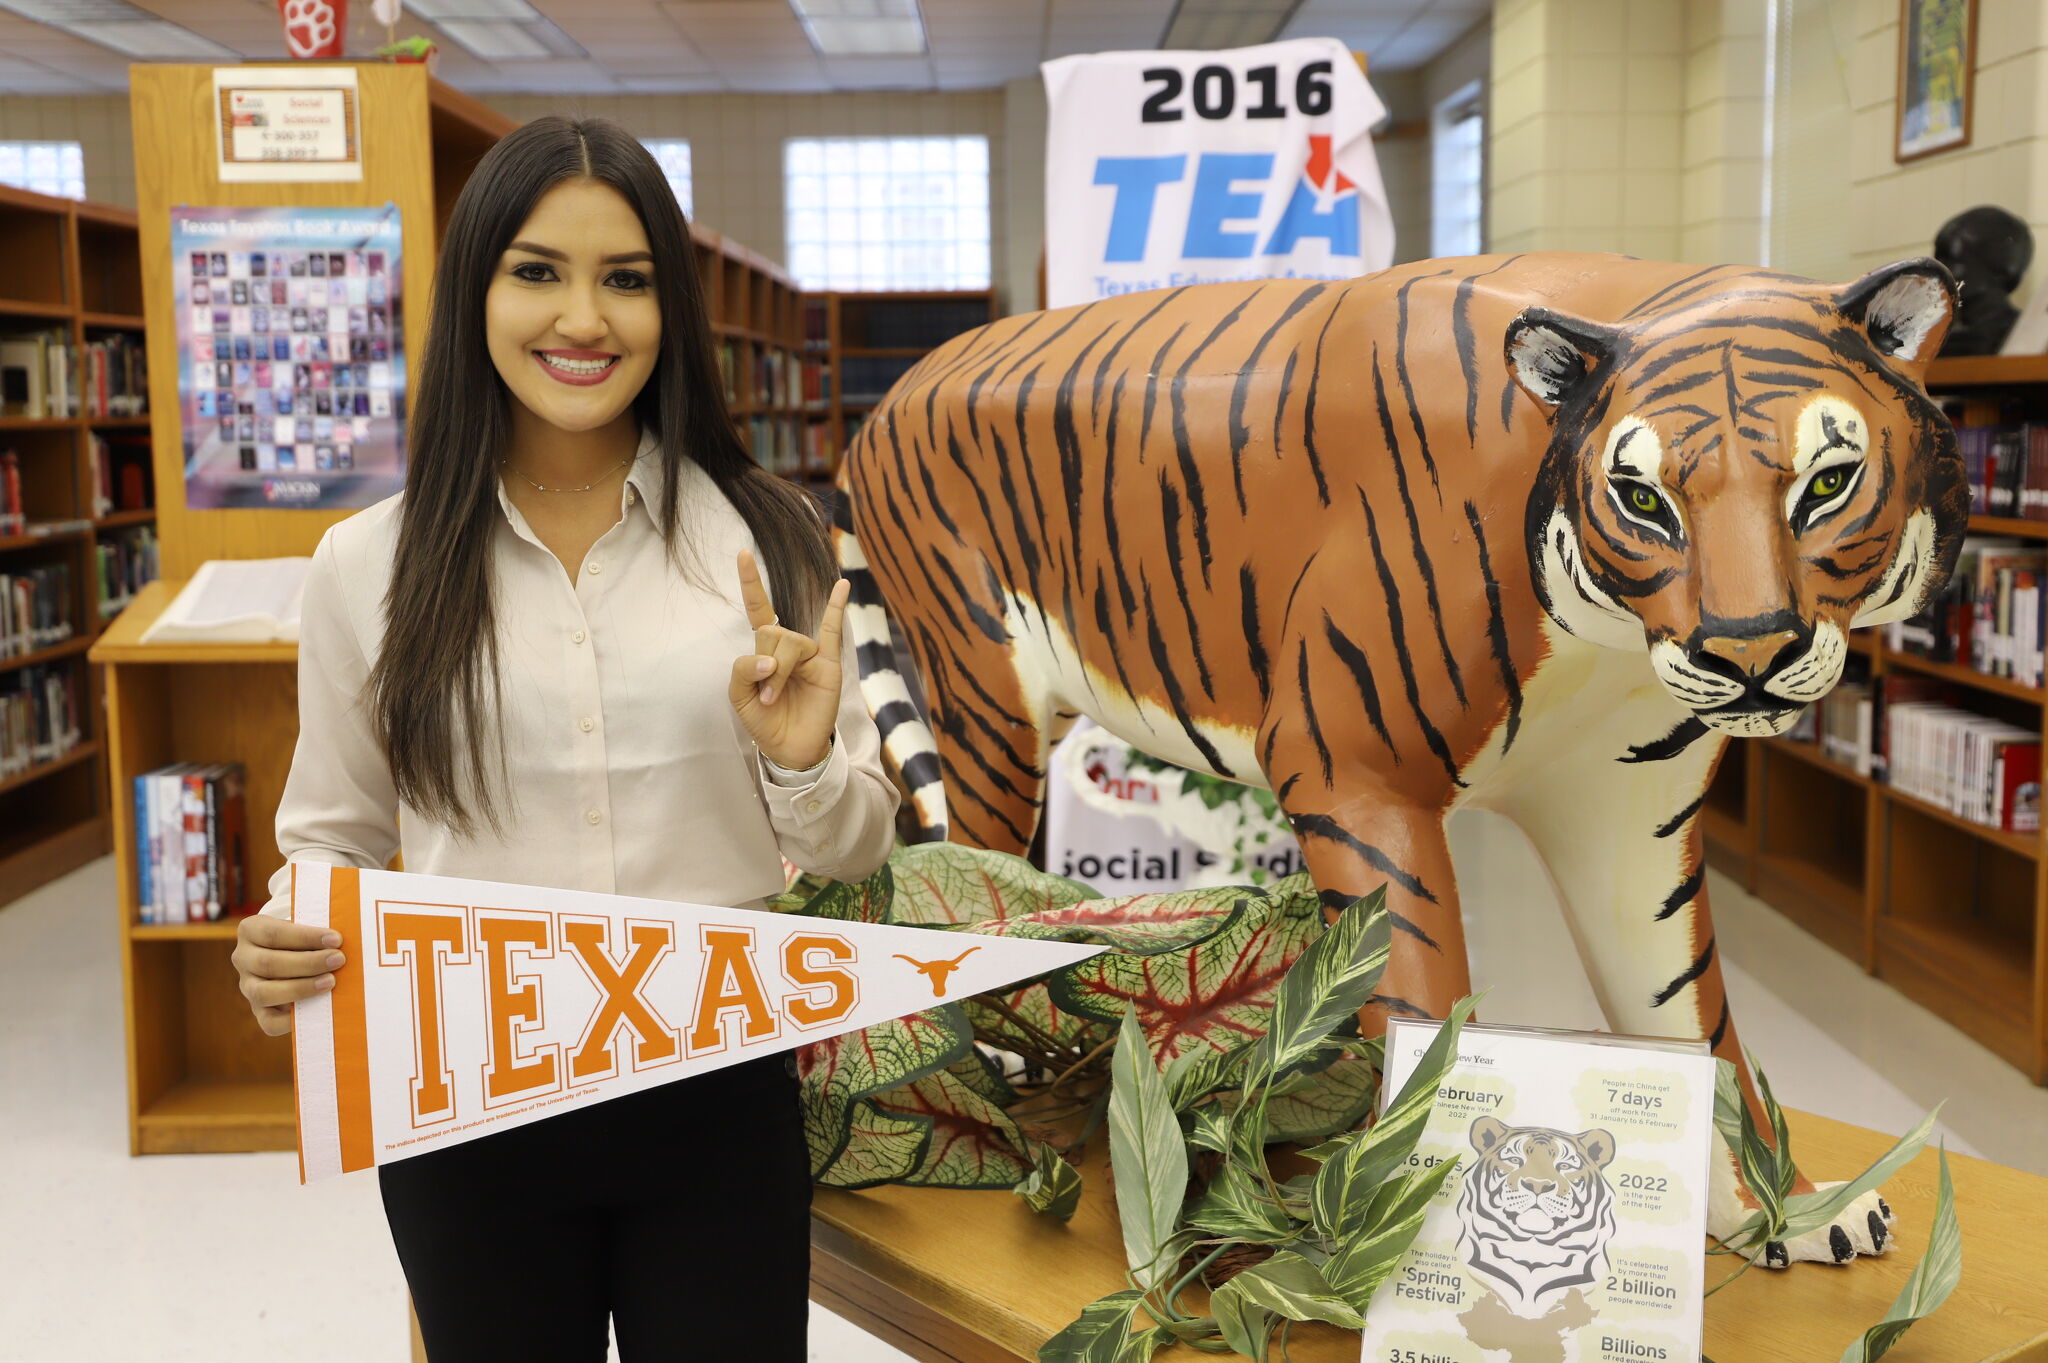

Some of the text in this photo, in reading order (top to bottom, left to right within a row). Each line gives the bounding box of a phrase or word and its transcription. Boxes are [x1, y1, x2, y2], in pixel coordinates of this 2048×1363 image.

[1141, 60, 1333, 123] 2016
[1093, 150, 1360, 263] TEA
[375, 899, 860, 1129] TEXAS
[1473, 1055, 1495, 1065] Year
[1602, 1079, 1670, 1094] People in China get
[1437, 1086, 1504, 1108] ebruary
[1607, 1088, 1663, 1110] 7 days
[1434, 1101, 1493, 1113] hinese New Year
[1621, 1108, 1639, 1117] work
[1640, 1110, 1658, 1118] from
[396, 1138, 416, 1147] indicia
[416, 1131, 442, 1143] depicted
[462, 1119, 485, 1131] product
[495, 1107, 528, 1120] trademarks
[536, 1101, 547, 1109] The
[547, 1094, 575, 1105] University
[1448, 1111, 1468, 1119] 2022
[1600, 1114, 1628, 1124] January
[1645, 1119, 1678, 1130] February
[1619, 1173, 1668, 1193] 2022
[1645, 1194, 1662, 1202] year
[1644, 1202, 1663, 1211] tiger
[1410, 1249, 1424, 1257] The
[1424, 1250, 1450, 1262] holiday
[1629, 1260, 1669, 1271] celebrated
[1606, 1276, 1676, 1299] 2 billion
[1608, 1296, 1673, 1310] people worldwide
[1601, 1336, 1667, 1360] Billions
[1612, 1355, 1625, 1363] red
